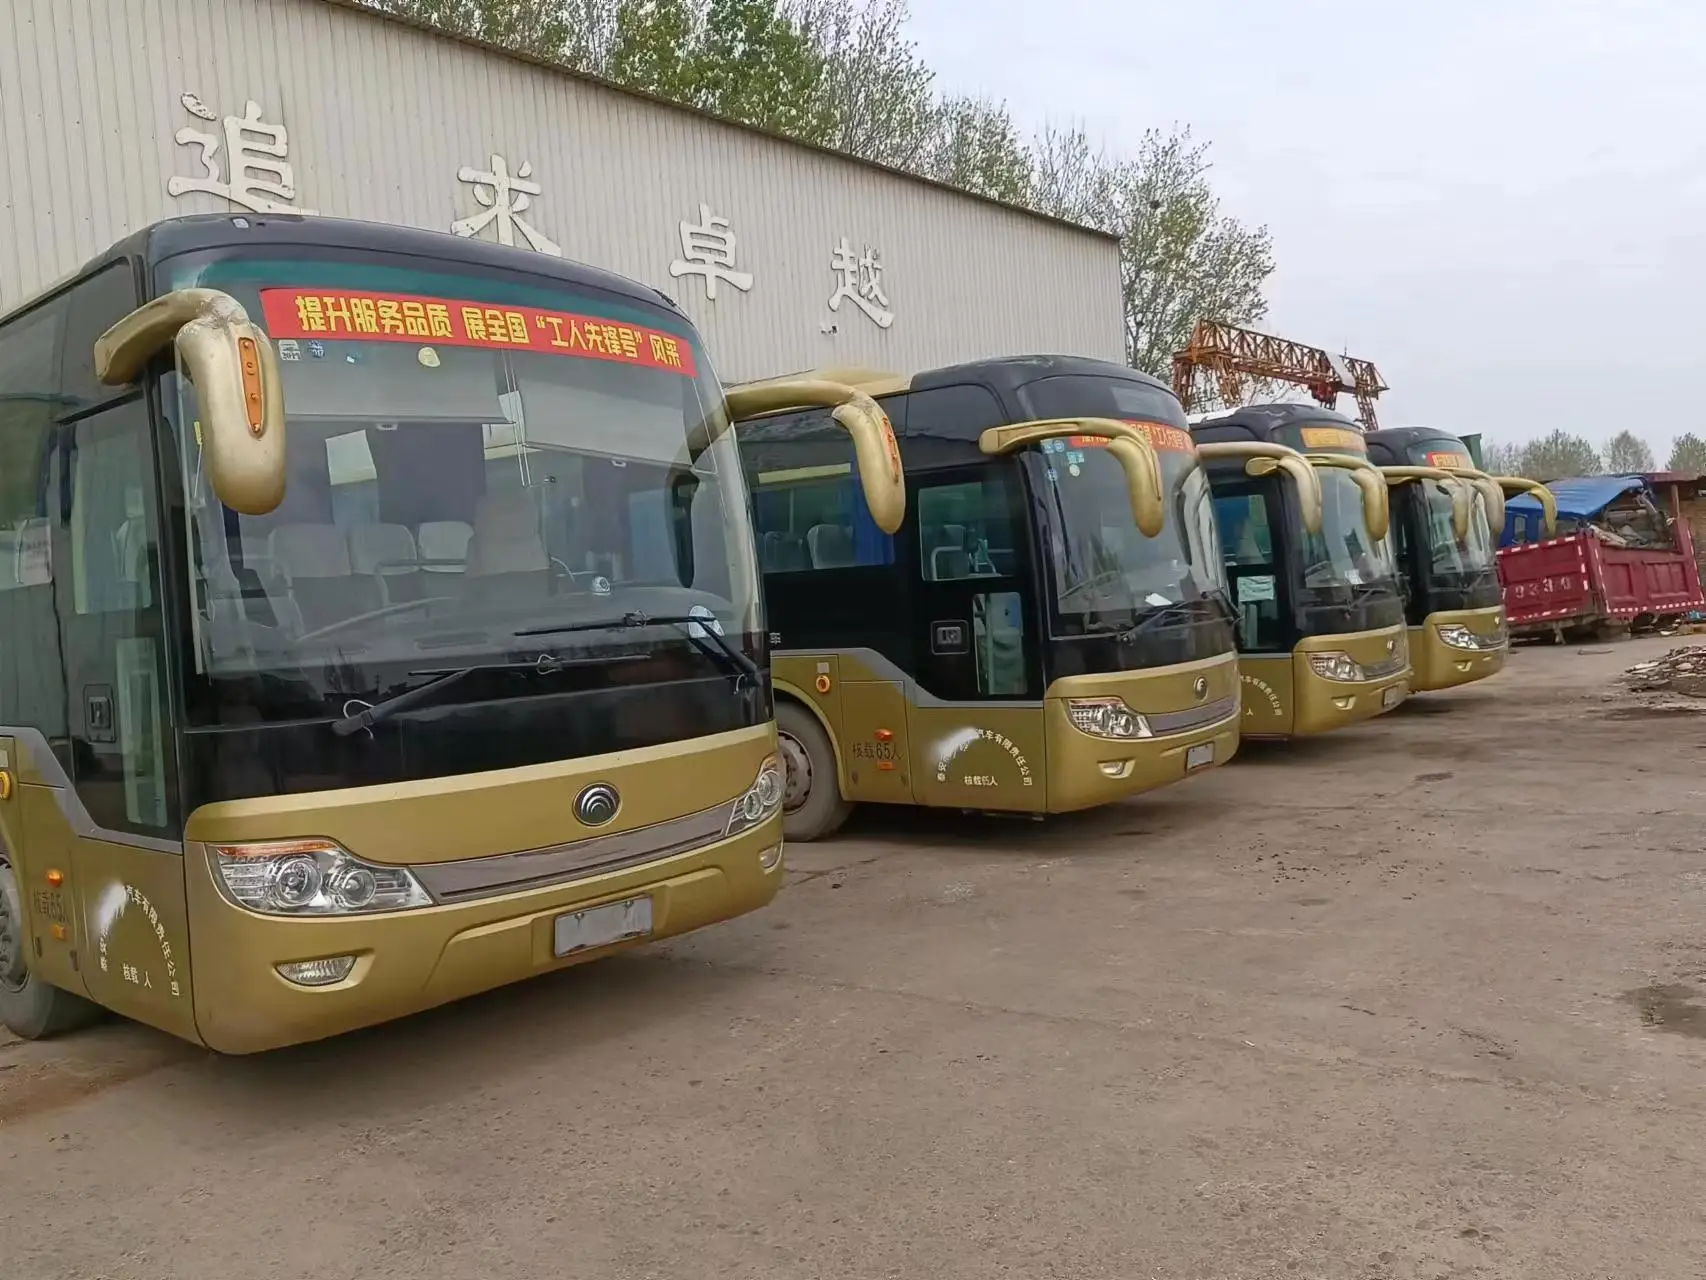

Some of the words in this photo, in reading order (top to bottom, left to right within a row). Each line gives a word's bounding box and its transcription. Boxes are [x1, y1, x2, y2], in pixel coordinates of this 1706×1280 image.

[296, 295, 452, 338] 提升服务品质
